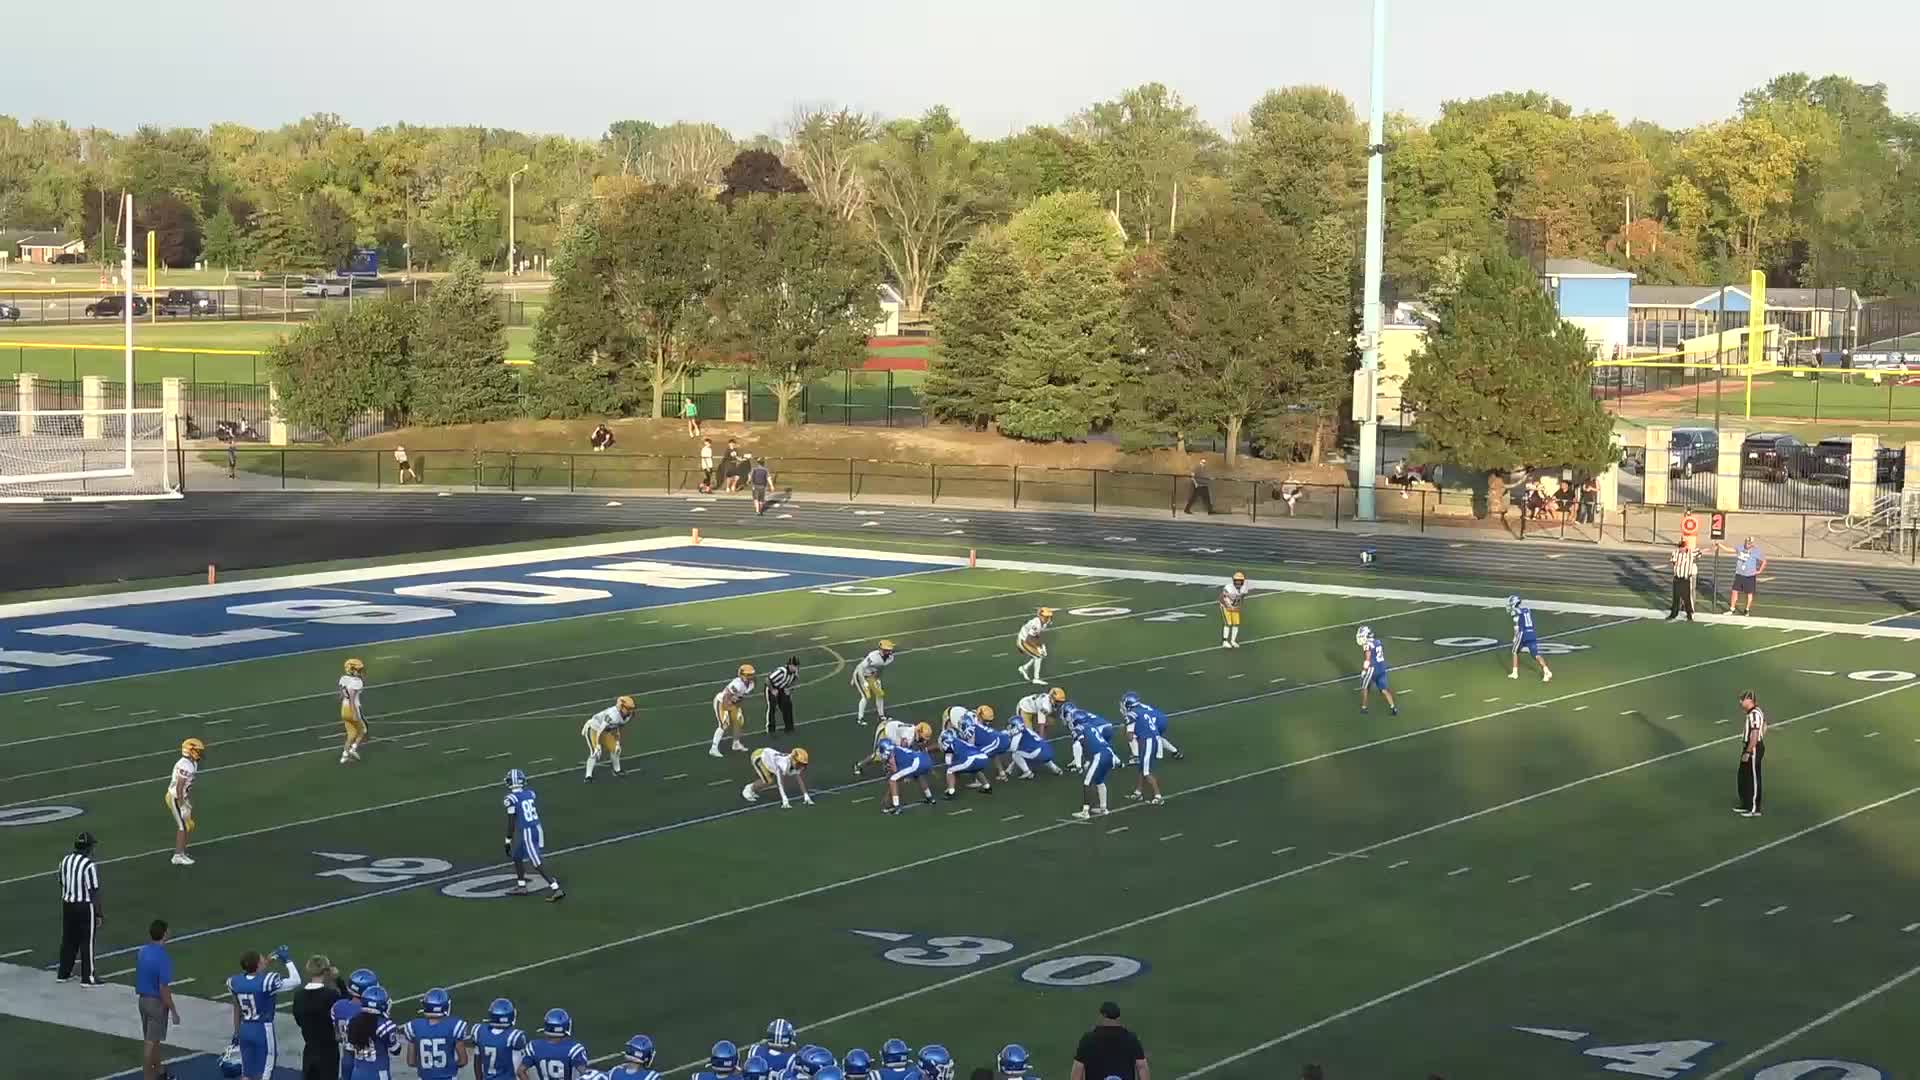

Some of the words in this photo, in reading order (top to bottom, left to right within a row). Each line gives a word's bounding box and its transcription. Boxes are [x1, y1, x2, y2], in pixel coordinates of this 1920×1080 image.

[521, 799, 539, 822] 85
[884, 935, 1142, 985] 30
[237, 993, 260, 1021] 51
[419, 1037, 448, 1069] 65
[483, 1046, 498, 1075] 7
[1583, 1040, 1881, 1080] 40
